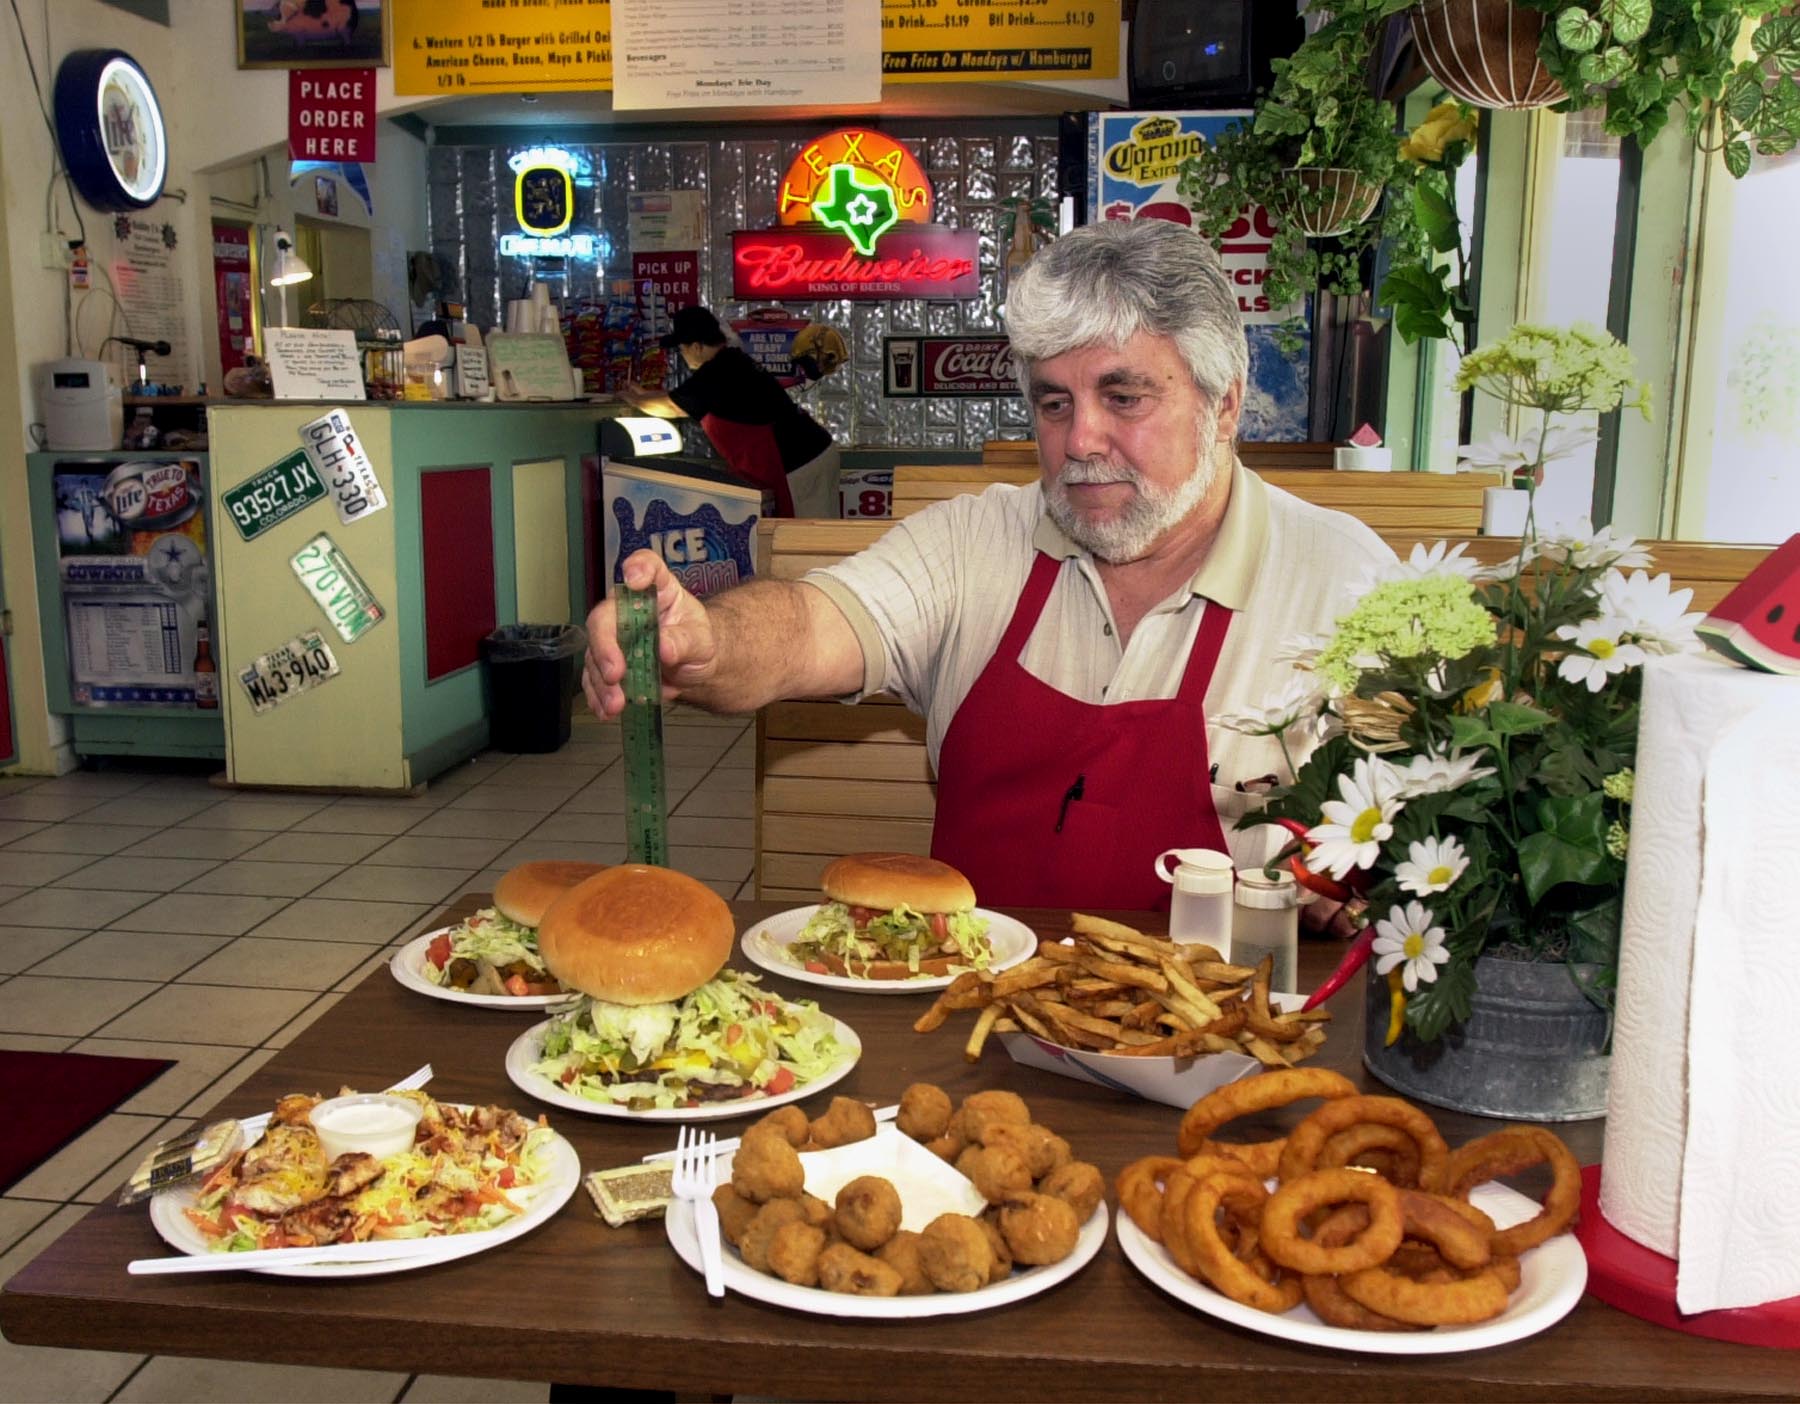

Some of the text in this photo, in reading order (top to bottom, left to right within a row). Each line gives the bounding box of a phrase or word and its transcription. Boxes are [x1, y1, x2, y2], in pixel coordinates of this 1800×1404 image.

[425, 36, 463, 49] Western
[468, 35, 482, 48] 1/2
[486, 34, 495, 47] lb
[500, 33, 530, 49] Burger
[534, 32, 555, 45] with
[559, 31, 591, 44] Grilled
[595, 30, 611, 43] Oni
[426, 55, 469, 68] American
[548, 51, 572, 67] Mayo
[575, 51, 582, 63] &
[587, 50, 612, 63] Pickl
[626, 54, 667, 62] Beverages
[882, 50, 1089, 69] Free Fries On Mondays w/ Hamburger
[456, 73, 465, 86] lb
[301, 81, 363, 99] PLACE
[300, 110, 364, 128] ORDER
[306, 138, 357, 156] HERE
[1109, 136, 1204, 175] Corona
[780, 133, 927, 213] TEXAS
[1141, 165, 1179, 180] Extra
[638, 262, 692, 275] PICK UP
[736, 243, 974, 288] Budweiser
[808, 282, 900, 293] KING OF BEERS
[171, 468, 184, 482] TO
[148, 486, 185, 513] TEXAS
[258, 494, 308, 527] COLORADO
[650, 527, 708, 563] ICE
